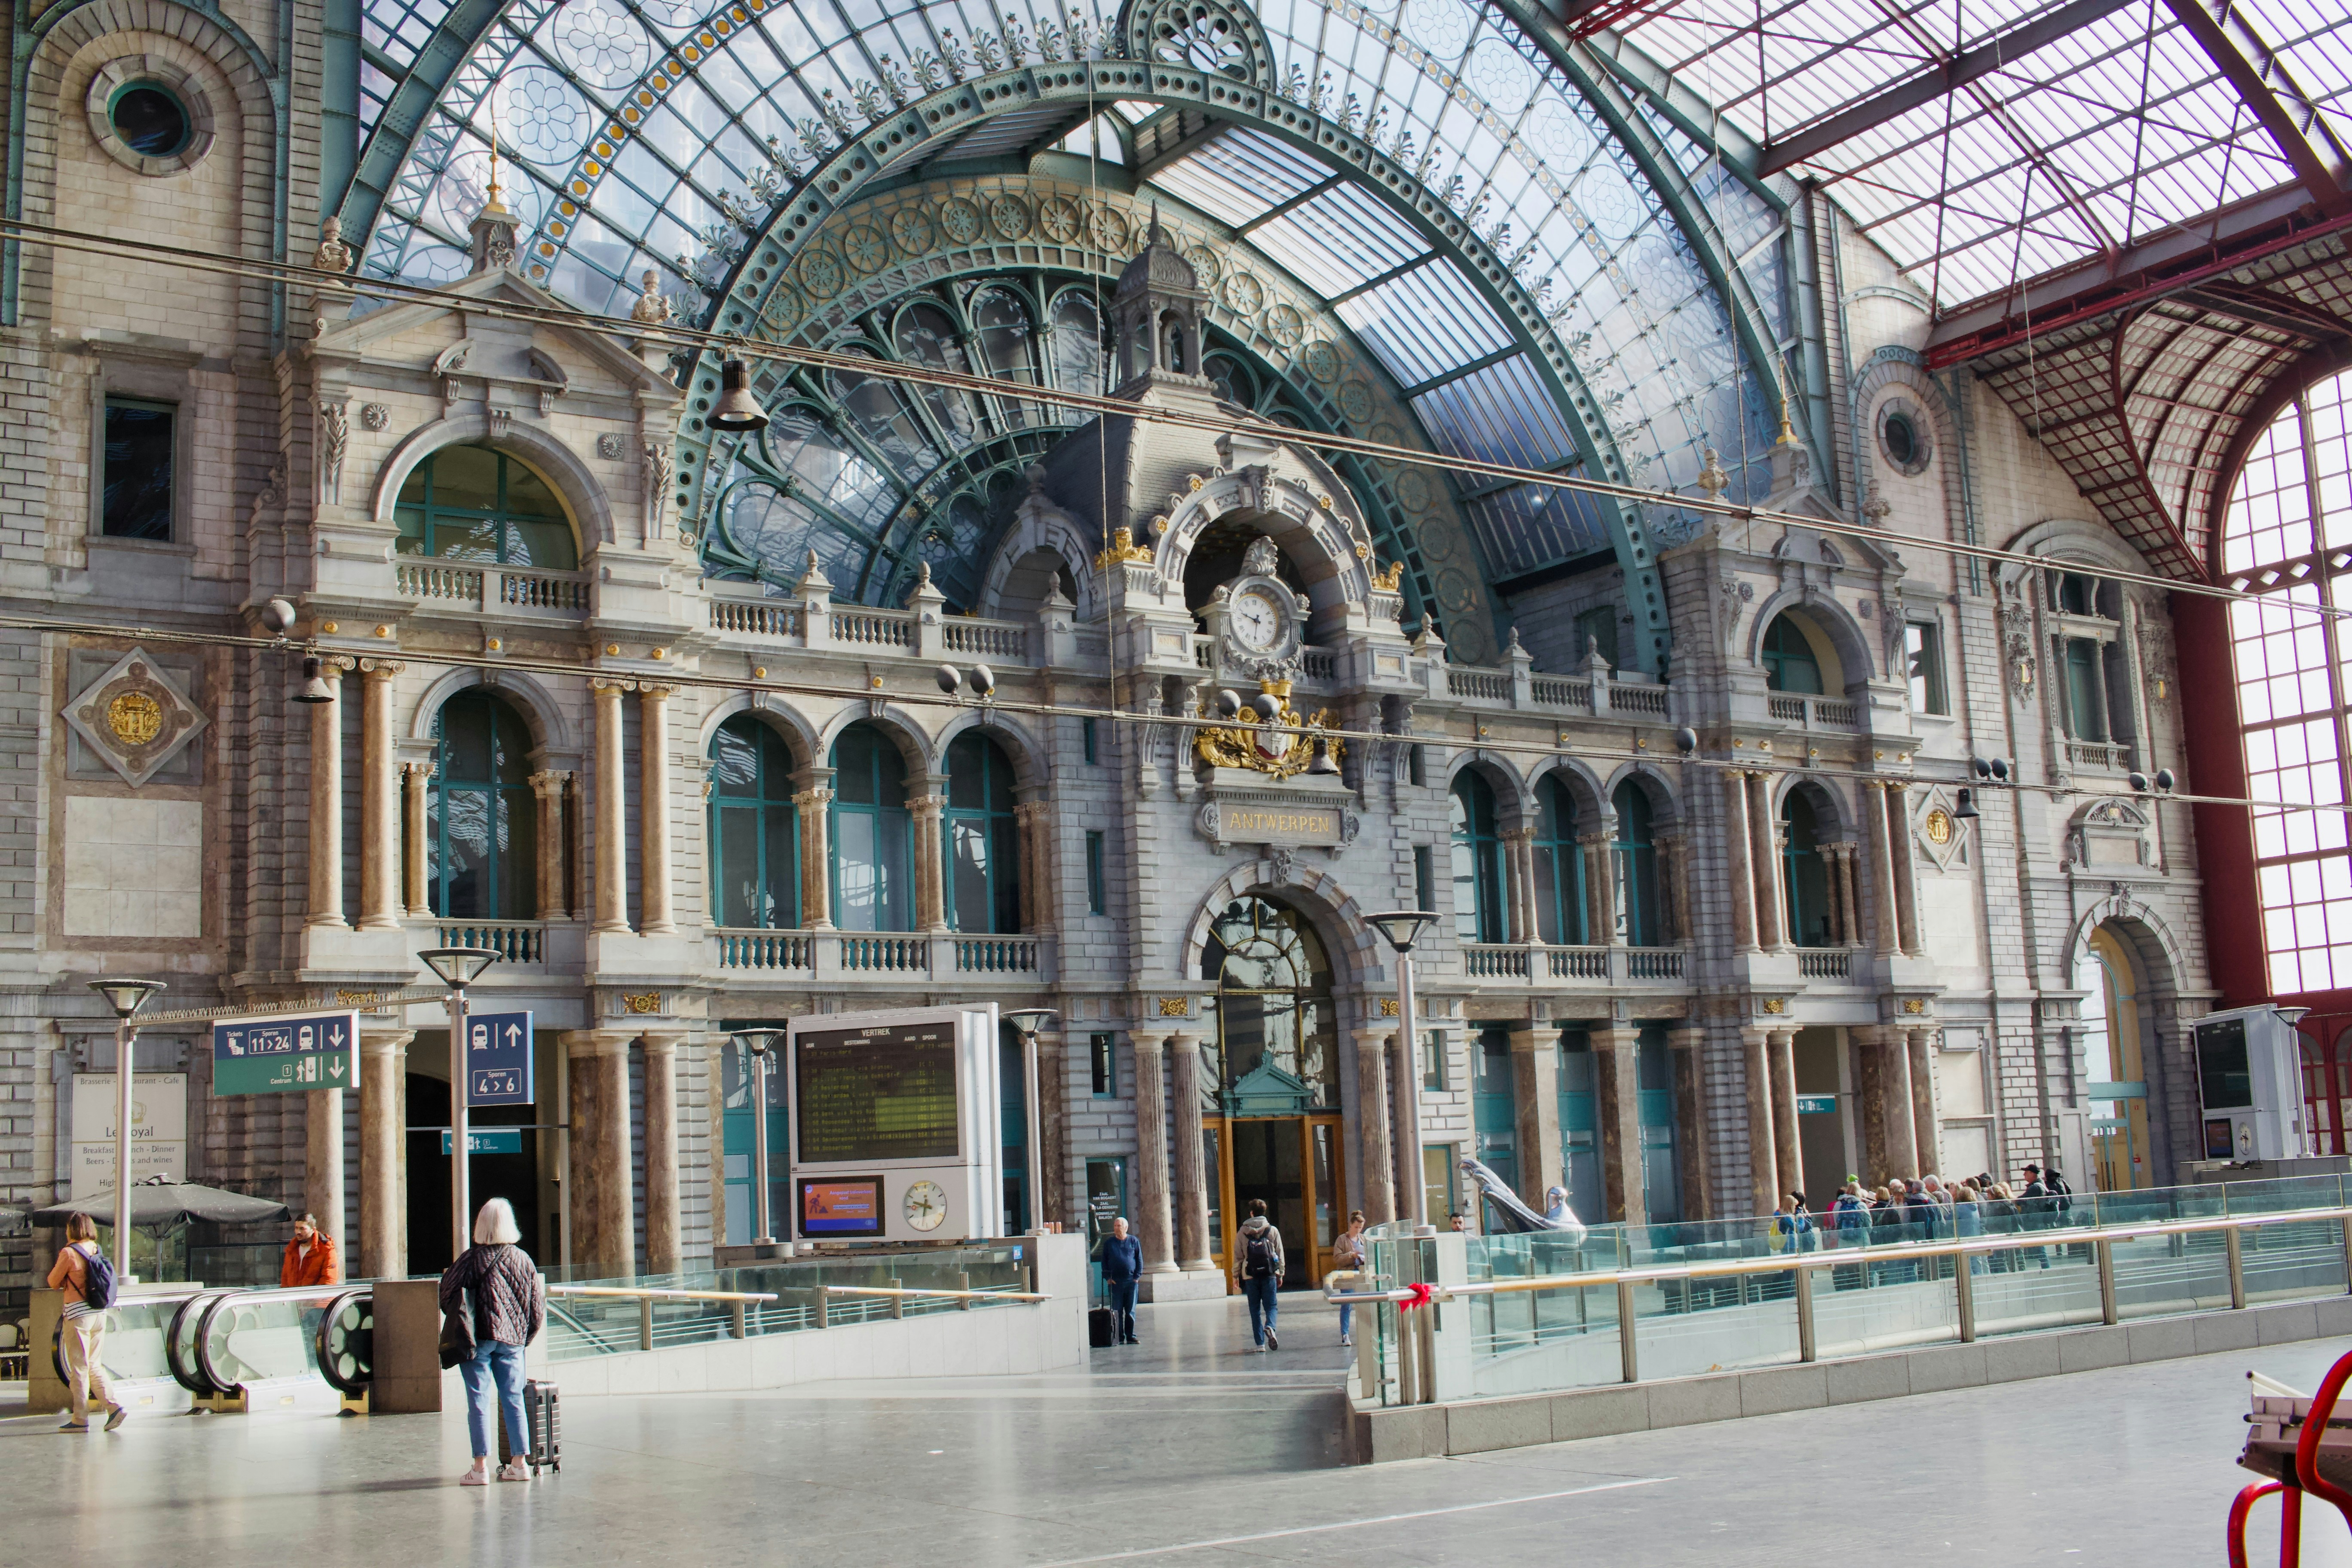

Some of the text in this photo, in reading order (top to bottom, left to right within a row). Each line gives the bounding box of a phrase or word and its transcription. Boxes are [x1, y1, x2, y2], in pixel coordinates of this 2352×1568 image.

[1230, 813, 1329, 832] ANTWERPEN
[862, 1028, 891, 1037] VERTREK
[479, 1079, 488, 1093] 4
[506, 1077, 515, 1092] 6
[106, 1126, 153, 1138] Le oyal
